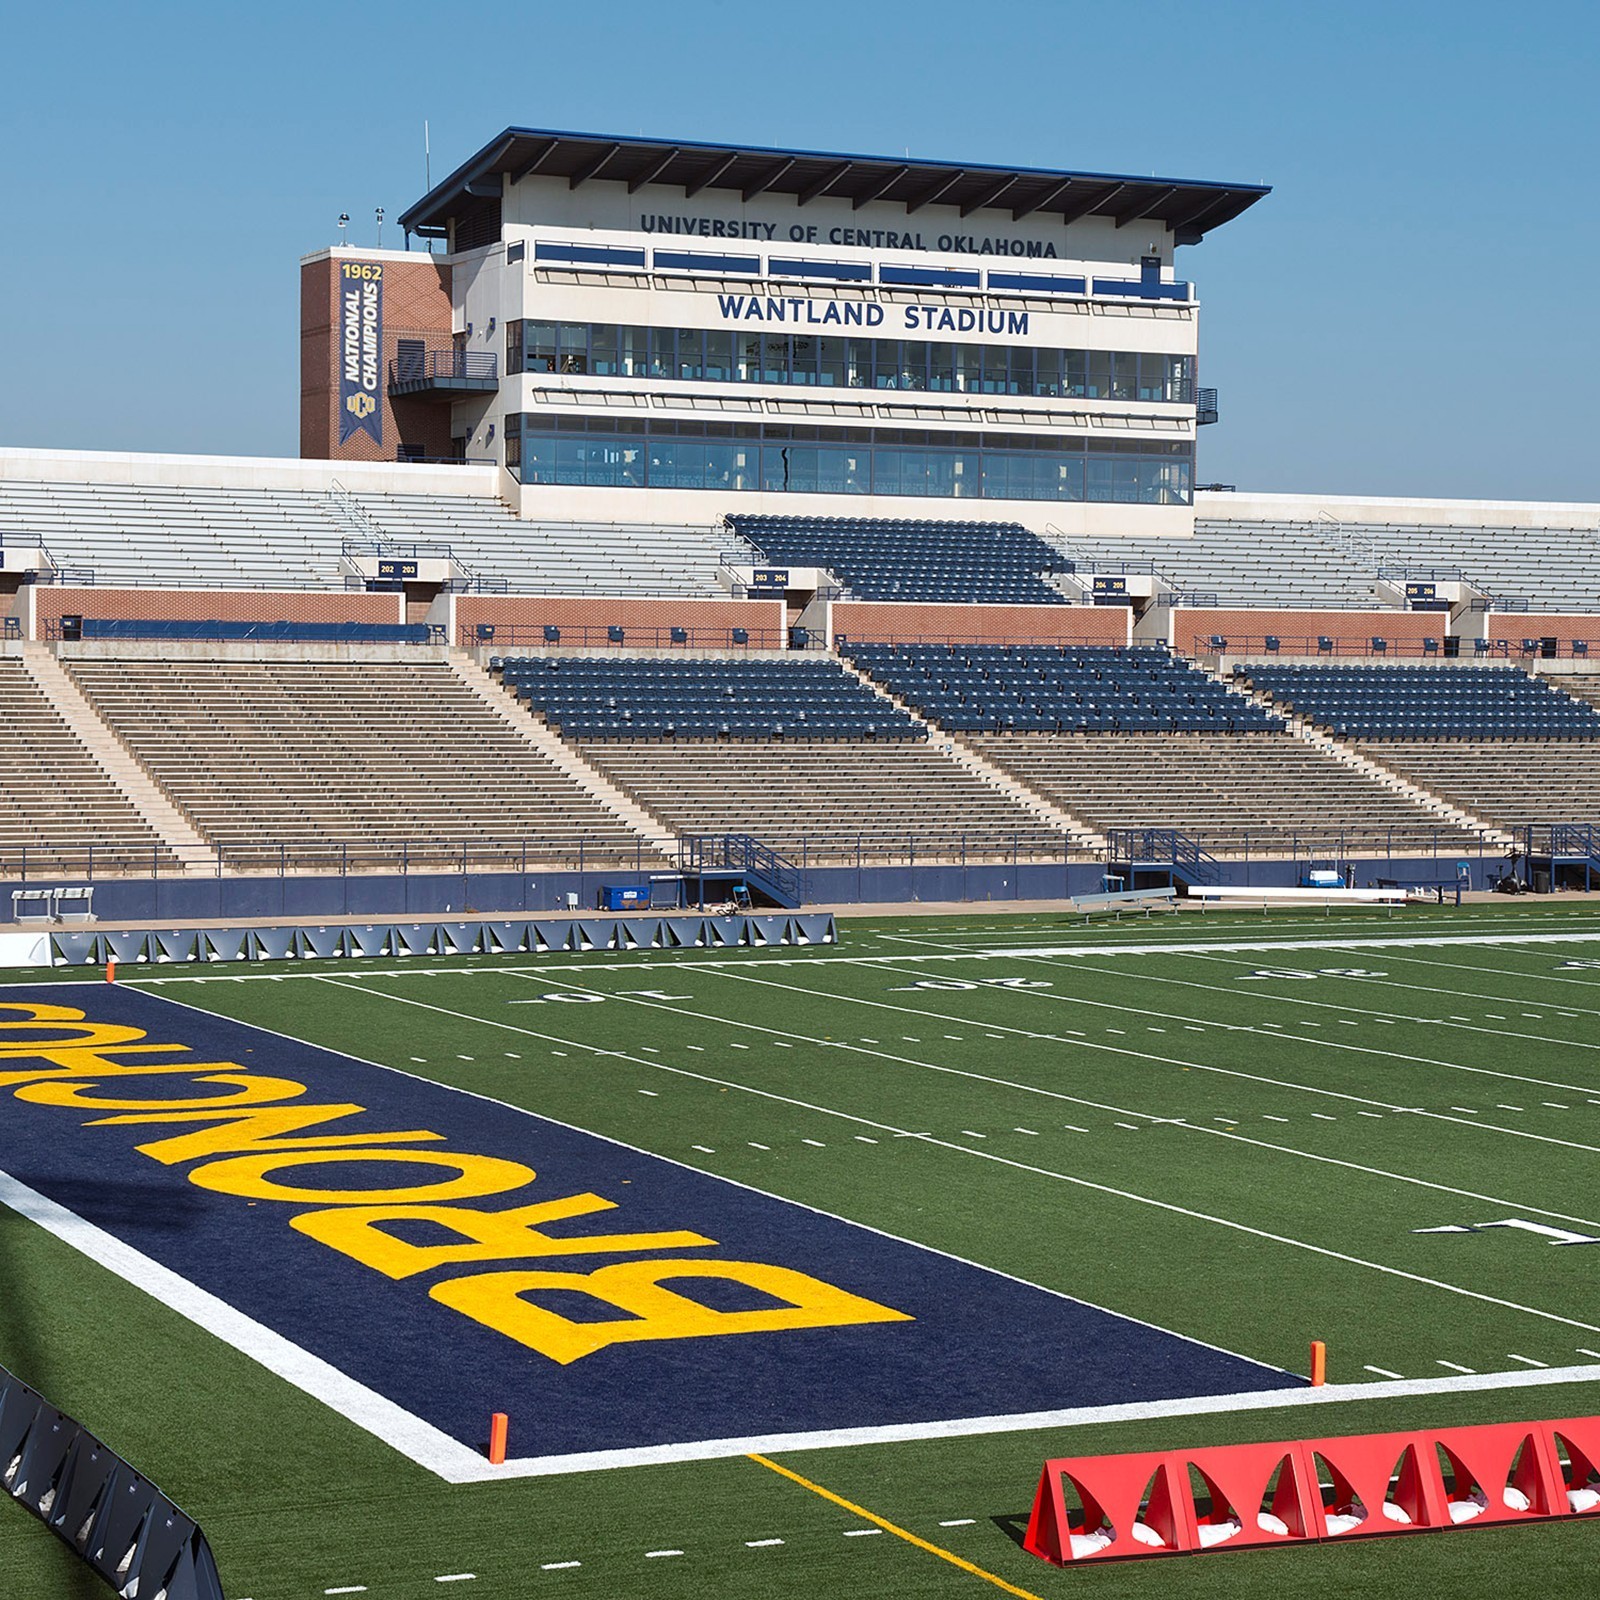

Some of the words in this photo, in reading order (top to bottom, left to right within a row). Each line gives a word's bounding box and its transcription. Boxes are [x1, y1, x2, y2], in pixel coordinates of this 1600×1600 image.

[641, 214, 777, 240] UNIVERSITY
[789, 224, 818, 244] OF
[829, 227, 927, 251] CENTRAL
[938, 235, 1057, 259] OKLAHOMA
[342, 264, 382, 280] 1962
[345, 290, 360, 382] NATIONAL
[363, 281, 378, 391] CHAMPIONS
[717, 295, 885, 326] WANTLAND
[904, 305, 1030, 335] STADIUM
[381, 565, 394, 573] 202
